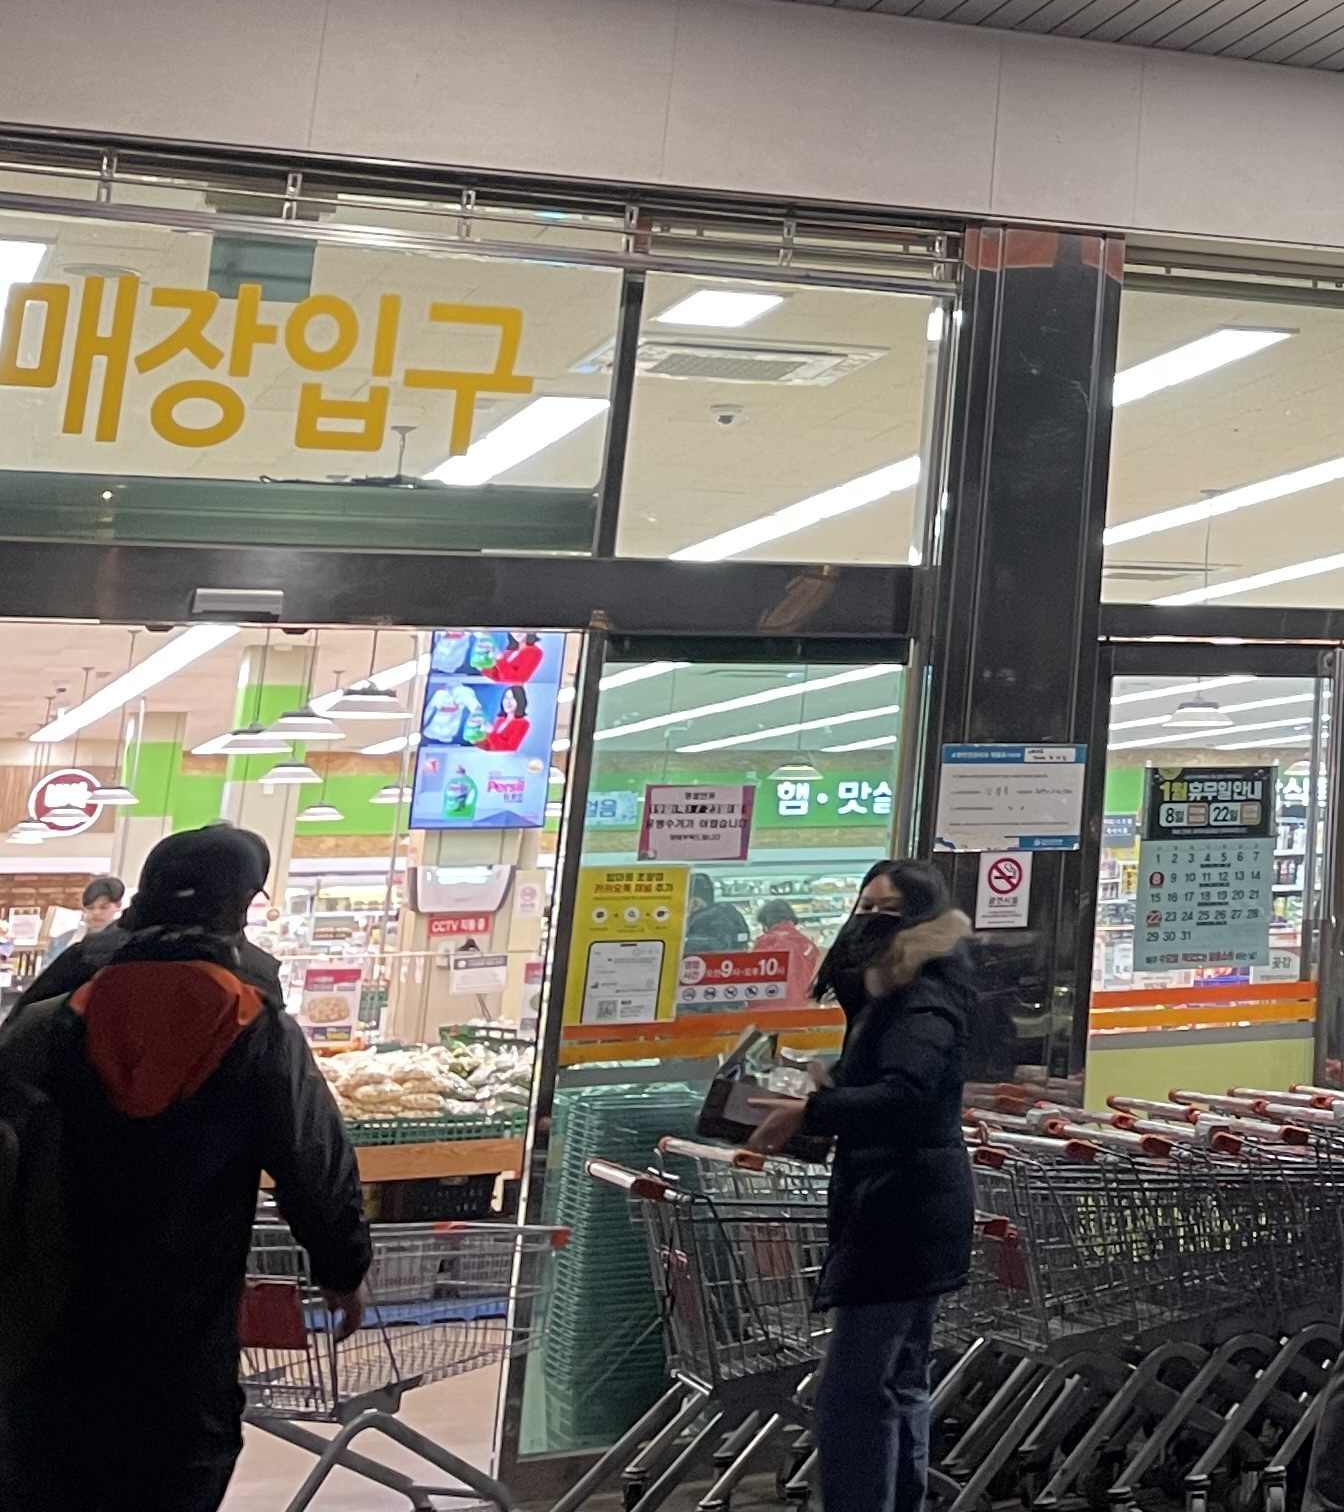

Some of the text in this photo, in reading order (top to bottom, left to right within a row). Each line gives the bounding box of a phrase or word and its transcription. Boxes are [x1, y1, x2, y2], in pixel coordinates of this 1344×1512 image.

[0, 275, 534, 456] 매장입구
[1185, 873, 1196, 882] 10
[1202, 872, 1211, 881] 11
[1218, 872, 1228, 881] 12
[1234, 871, 1245, 880] 13
[1250, 871, 1261, 880] 14
[1151, 890, 1259, 903] 15 16 17 18 19 20 21
[1164, 912, 1177, 922] 23
[1181, 912, 1193, 921] 24
[1198, 911, 1210, 921] 25
[1214, 910, 1226, 920] 26
[1231, 909, 1242, 919] 27
[1246, 909, 1259, 919] 28
[431, 919, 459, 933] CCTV
[1146, 931, 1192, 942] 29 30 31
